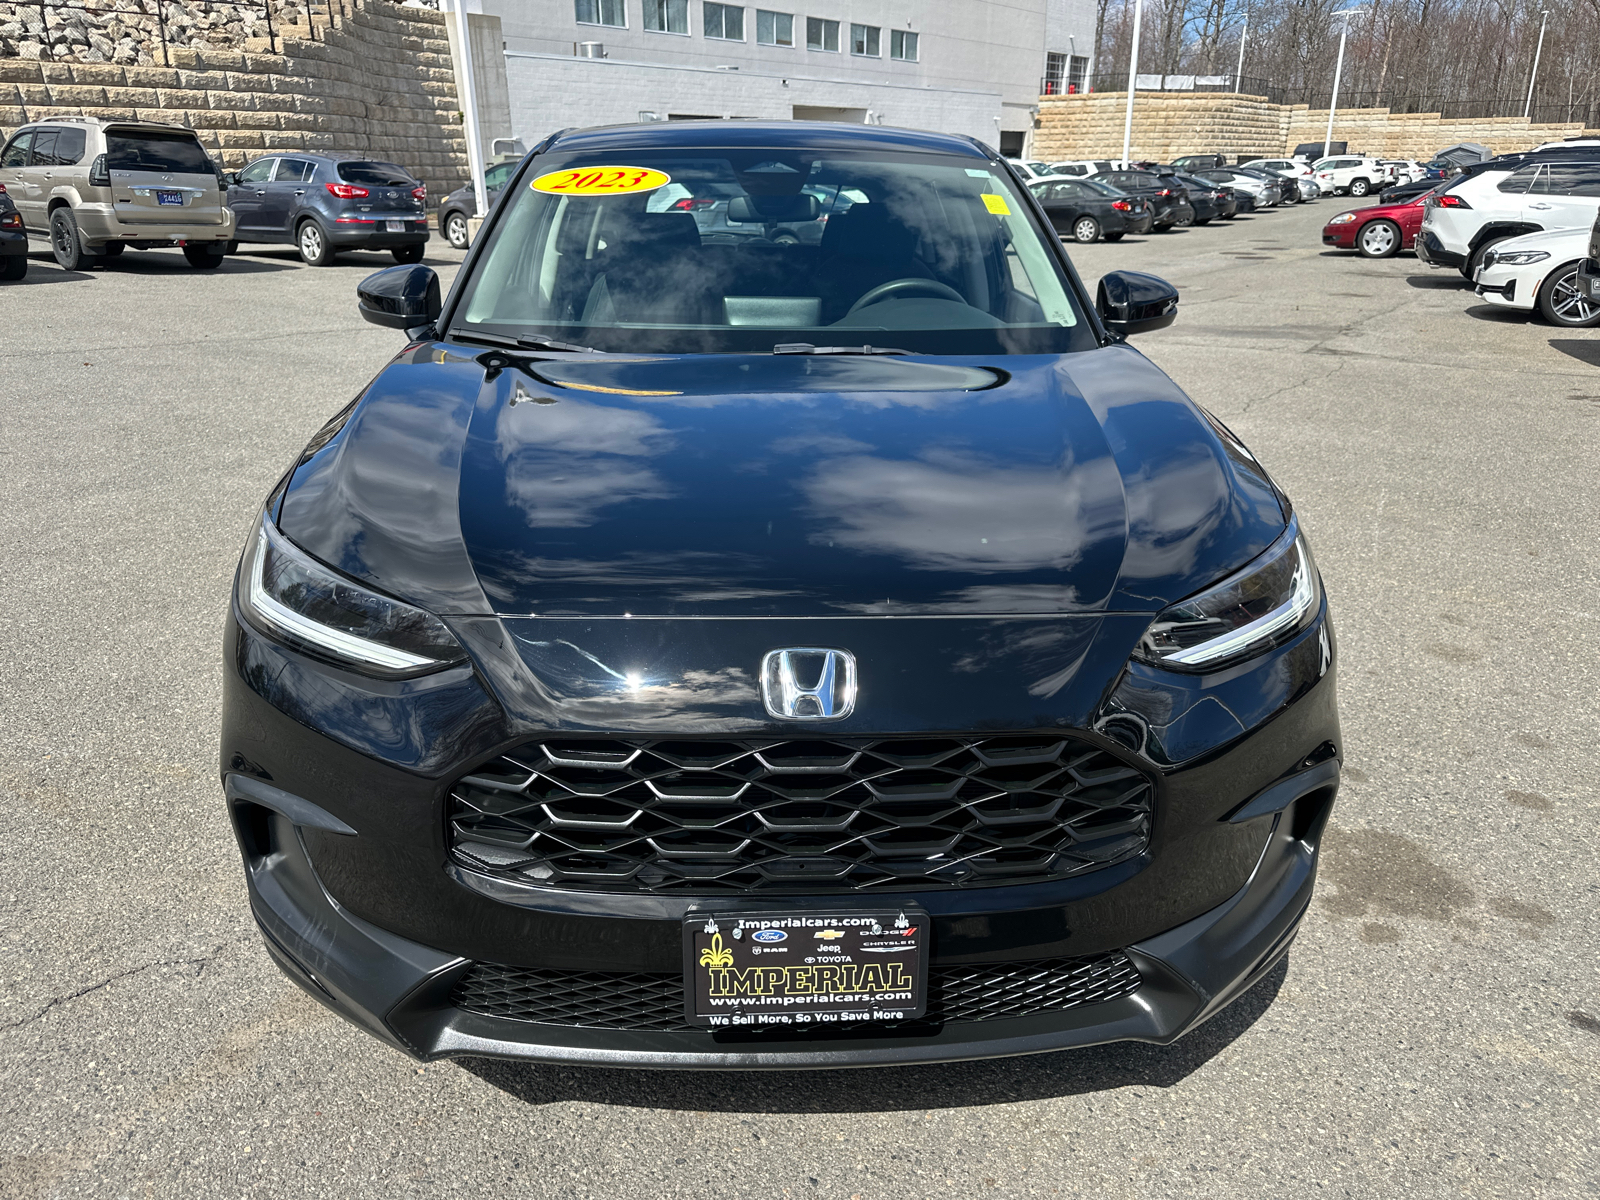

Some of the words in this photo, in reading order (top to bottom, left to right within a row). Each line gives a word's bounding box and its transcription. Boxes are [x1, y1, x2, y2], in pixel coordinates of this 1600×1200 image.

[549, 171, 649, 190] 2023
[738, 917, 877, 930] Imperialcars.com
[816, 944, 841, 953] Jeep
[817, 956, 852, 964] TOYOTA
[709, 963, 913, 996] IMPERIAL
[709, 991, 913, 1006] www.imperialcars.com
[709, 1016, 729, 1025] We
[732, 1015, 755, 1024] Sell
[758, 1014, 793, 1025] More,
[795, 1013, 812, 1023] So
[814, 1012, 838, 1022] You
[840, 1011, 870, 1021] Save
[872, 1011, 904, 1020] More
